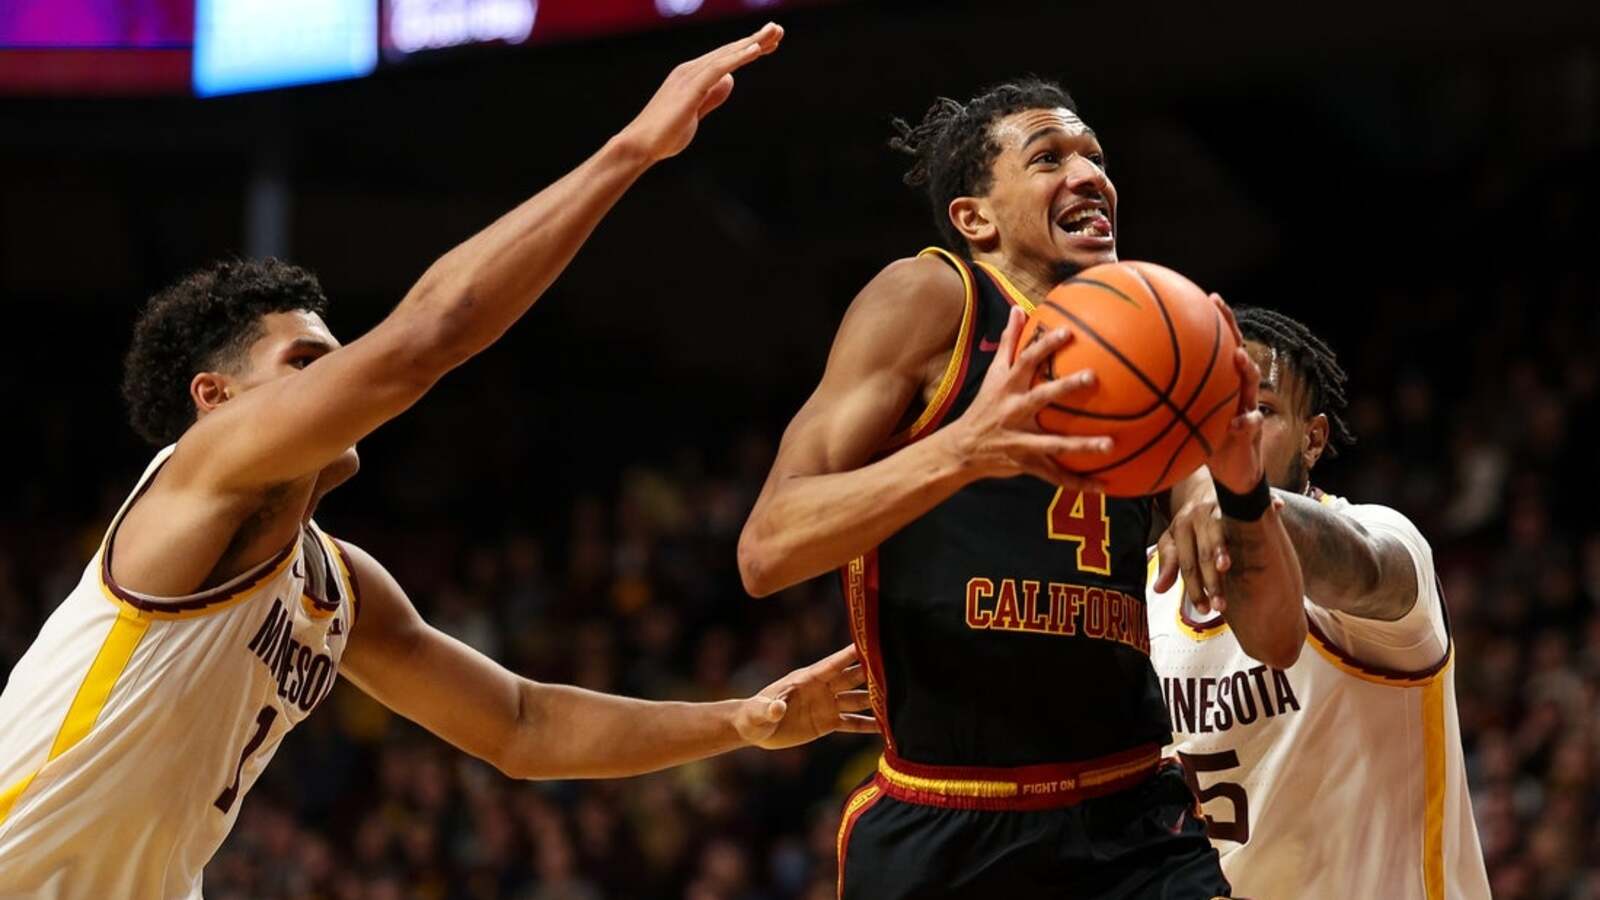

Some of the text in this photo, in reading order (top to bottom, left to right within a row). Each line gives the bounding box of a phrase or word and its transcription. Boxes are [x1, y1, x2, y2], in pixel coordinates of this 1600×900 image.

[1047, 485, 1111, 576] 4
[214, 705, 277, 814] 1
[1023, 779, 1076, 795] FIGHT ON
[1177, 749, 1250, 845] 5
